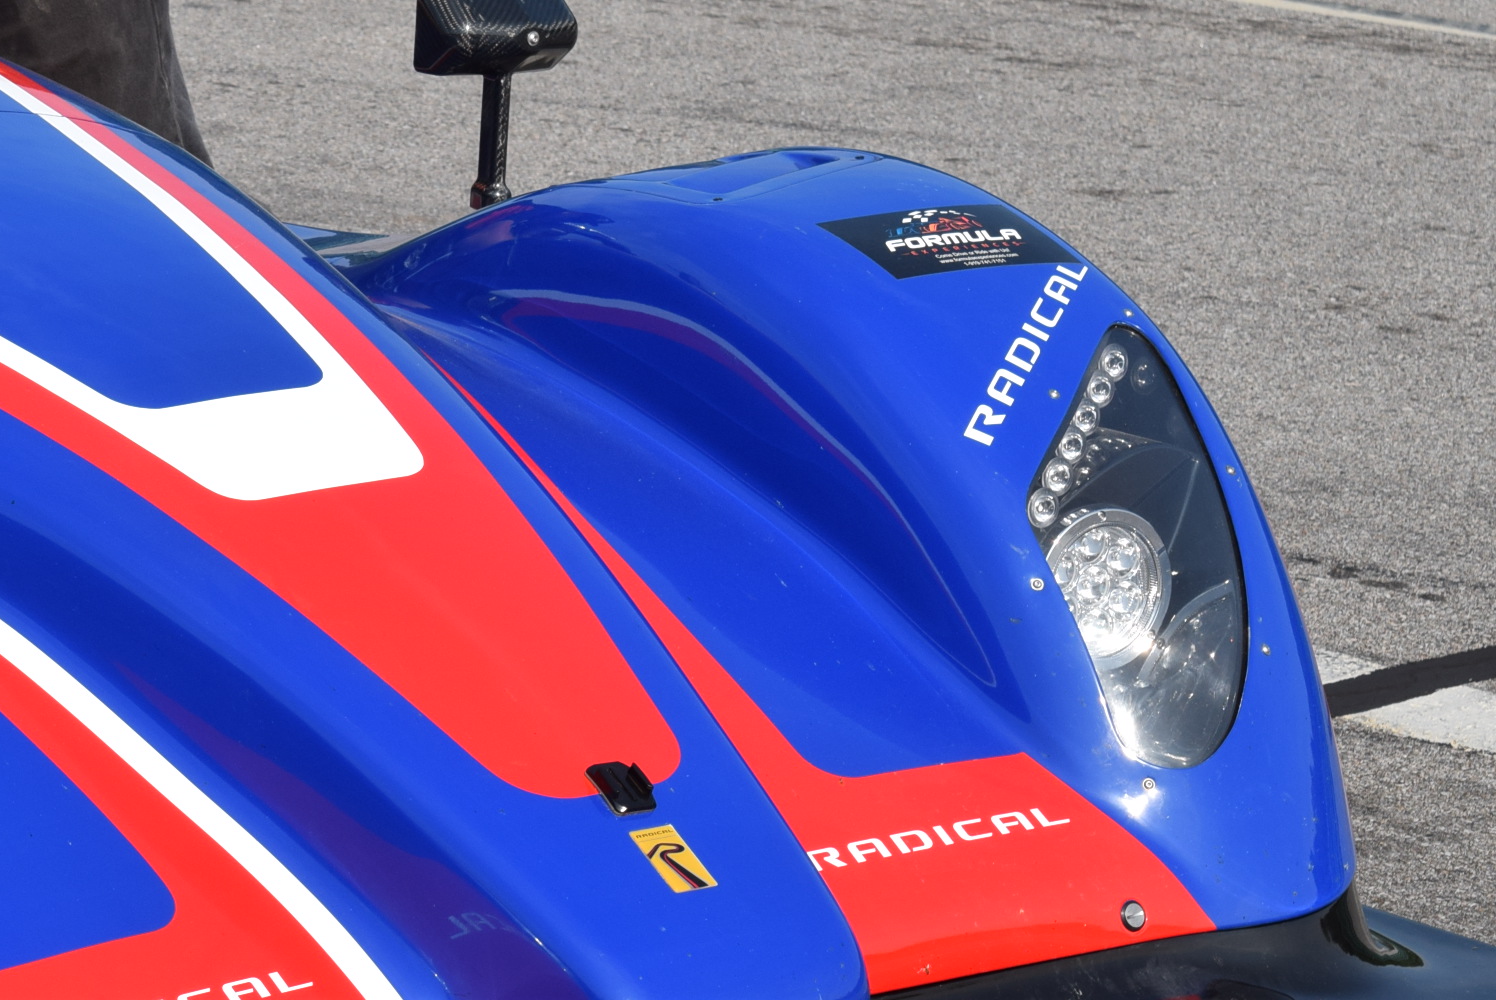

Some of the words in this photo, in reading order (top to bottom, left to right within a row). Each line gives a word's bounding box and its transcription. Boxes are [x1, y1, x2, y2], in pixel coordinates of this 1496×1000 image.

[885, 228, 1022, 252] FORMULA
[963, 264, 1088, 446] RADICAL
[635, 829, 674, 839] RADICAL
[807, 807, 1071, 871] RADICAL
